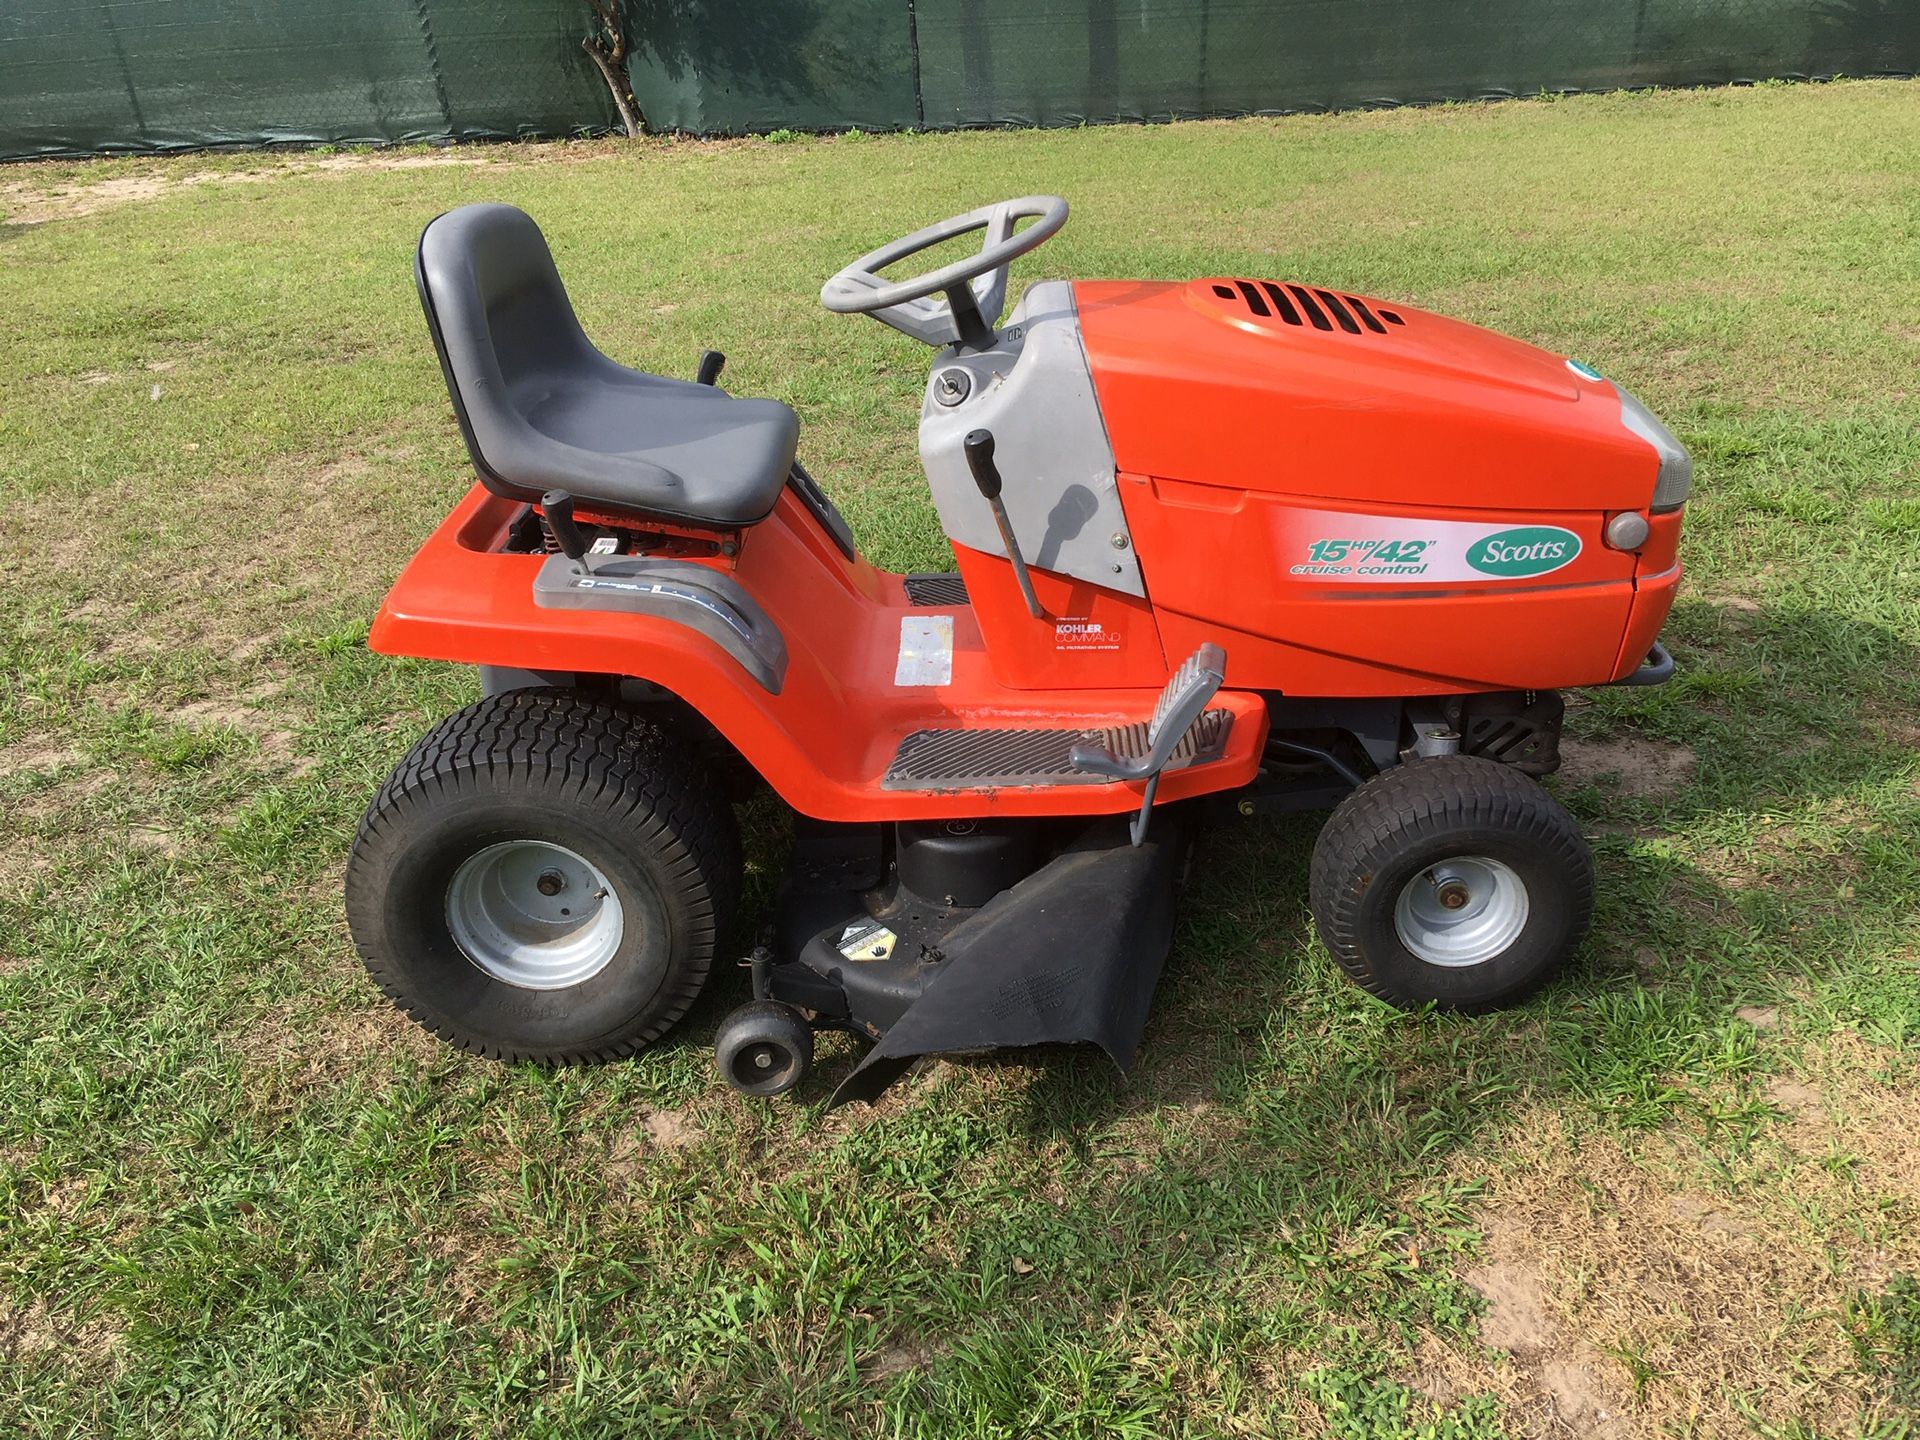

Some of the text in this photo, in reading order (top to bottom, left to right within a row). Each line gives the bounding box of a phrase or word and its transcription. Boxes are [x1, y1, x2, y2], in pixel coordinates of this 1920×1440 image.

[1480, 538, 1566, 565] Scotts
[1290, 563, 1429, 576] cruise control
[1056, 624, 1101, 633] KOHLER
[1055, 633, 1121, 642] COMMAND
